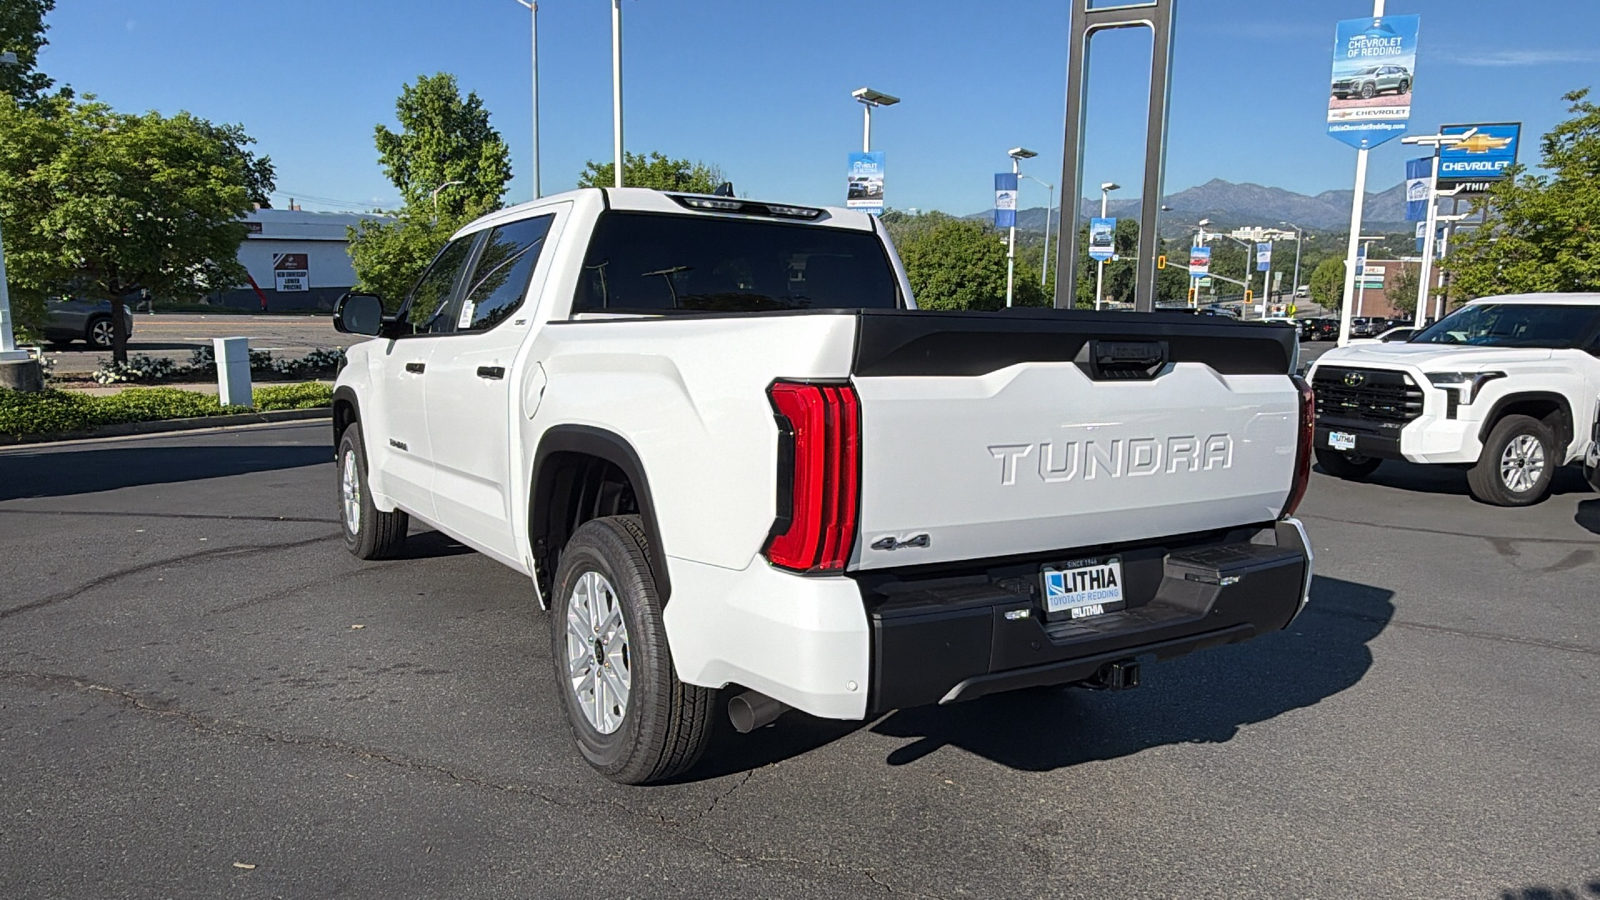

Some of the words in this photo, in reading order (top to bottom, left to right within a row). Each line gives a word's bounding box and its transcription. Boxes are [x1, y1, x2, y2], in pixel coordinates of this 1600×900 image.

[1348, 37, 1402, 49] CHEVROLET
[1348, 48, 1359, 58] OF
[1361, 46, 1402, 56] REDDING
[1442, 161, 1510, 171] CHEVROLET
[1336, 434, 1354, 443] LITHIA
[987, 433, 1233, 486] TUNDRA
[1067, 560, 1083, 568] SINCE
[1063, 567, 1117, 593] LITHIA
[1050, 596, 1076, 606] TOYOTA
[1077, 594, 1086, 602] OF
[1088, 589, 1119, 600] REDDING
[1080, 604, 1104, 617] LITHIA
